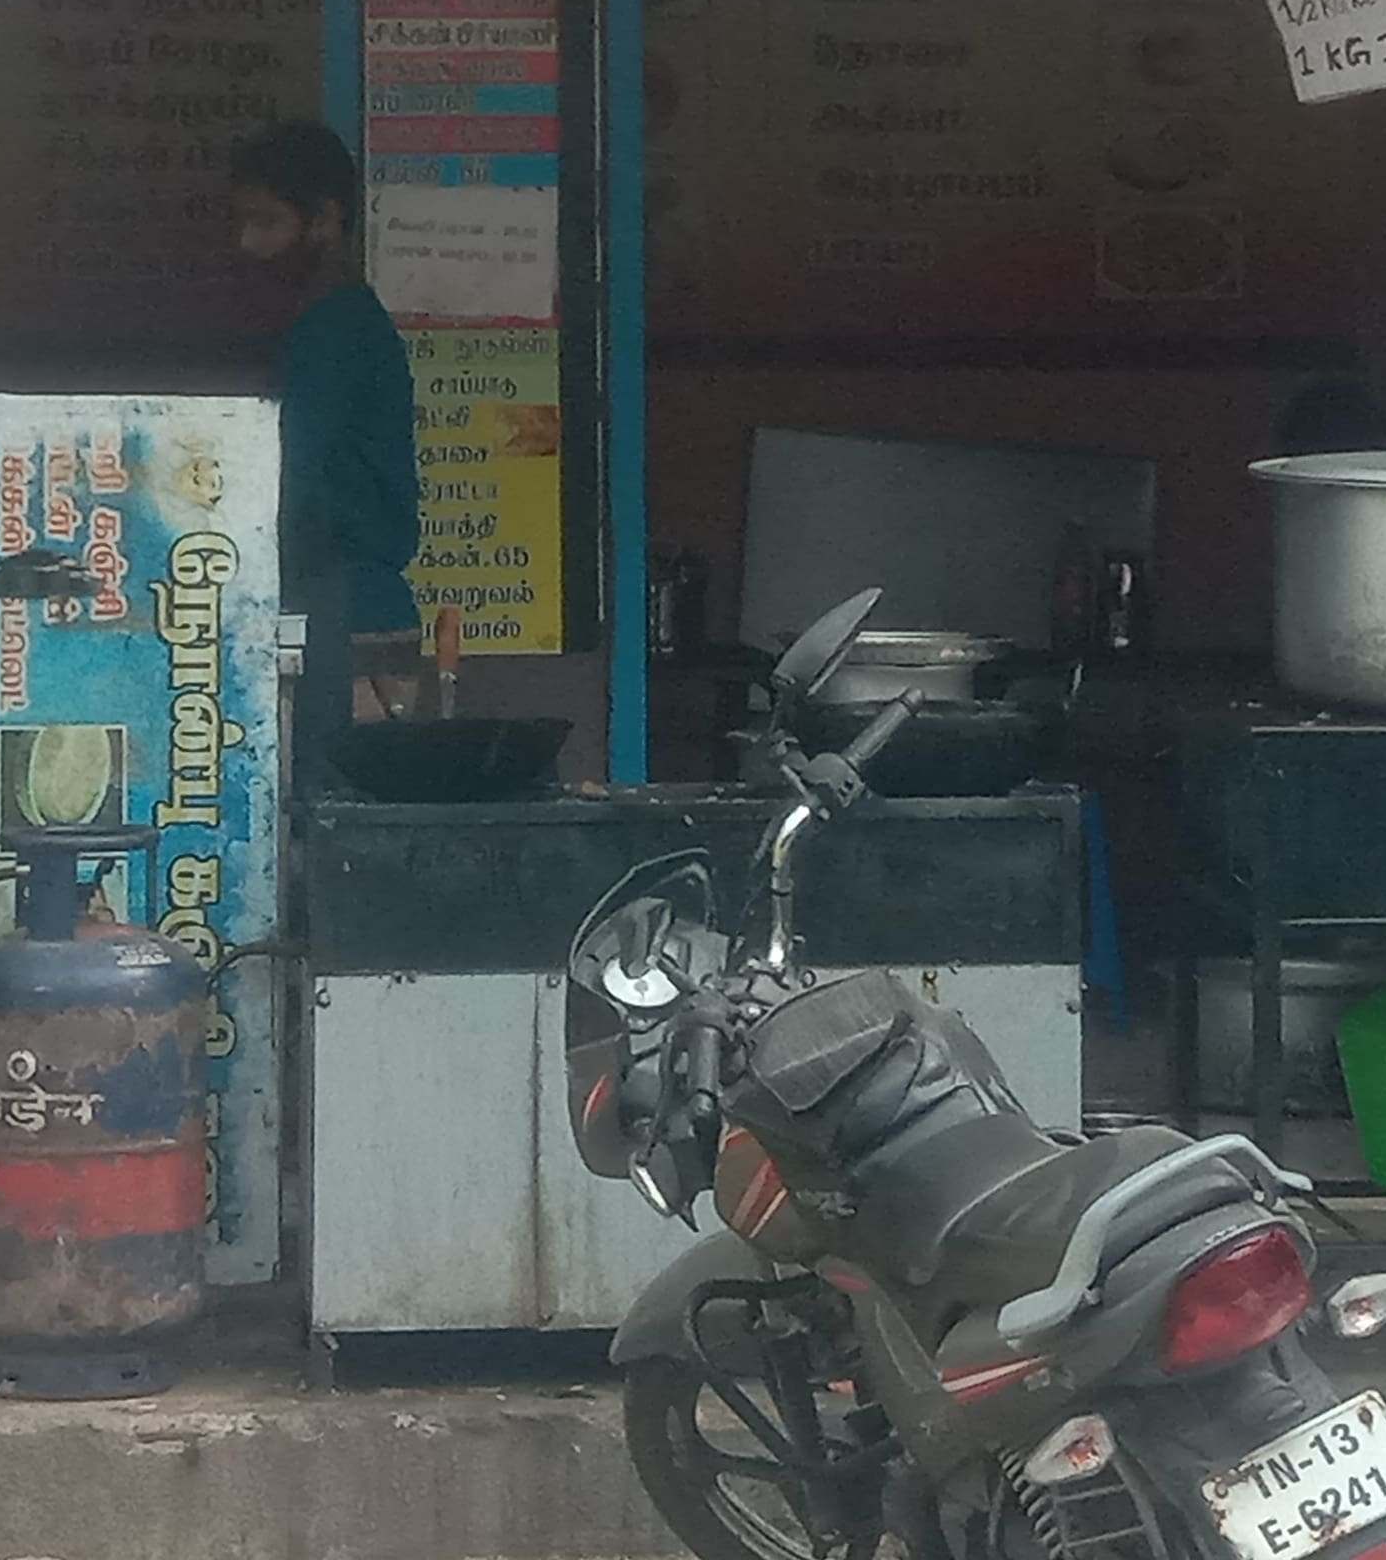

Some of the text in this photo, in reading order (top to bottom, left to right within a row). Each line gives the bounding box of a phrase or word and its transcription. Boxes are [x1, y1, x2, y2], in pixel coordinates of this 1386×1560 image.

[418, 543, 530, 569] க்கன்.65
[415, 579, 535, 613] ன்வறுவல்
[149, 530, 246, 829] நோன்பு
[1248, 1423, 1360, 1500] TN-13
